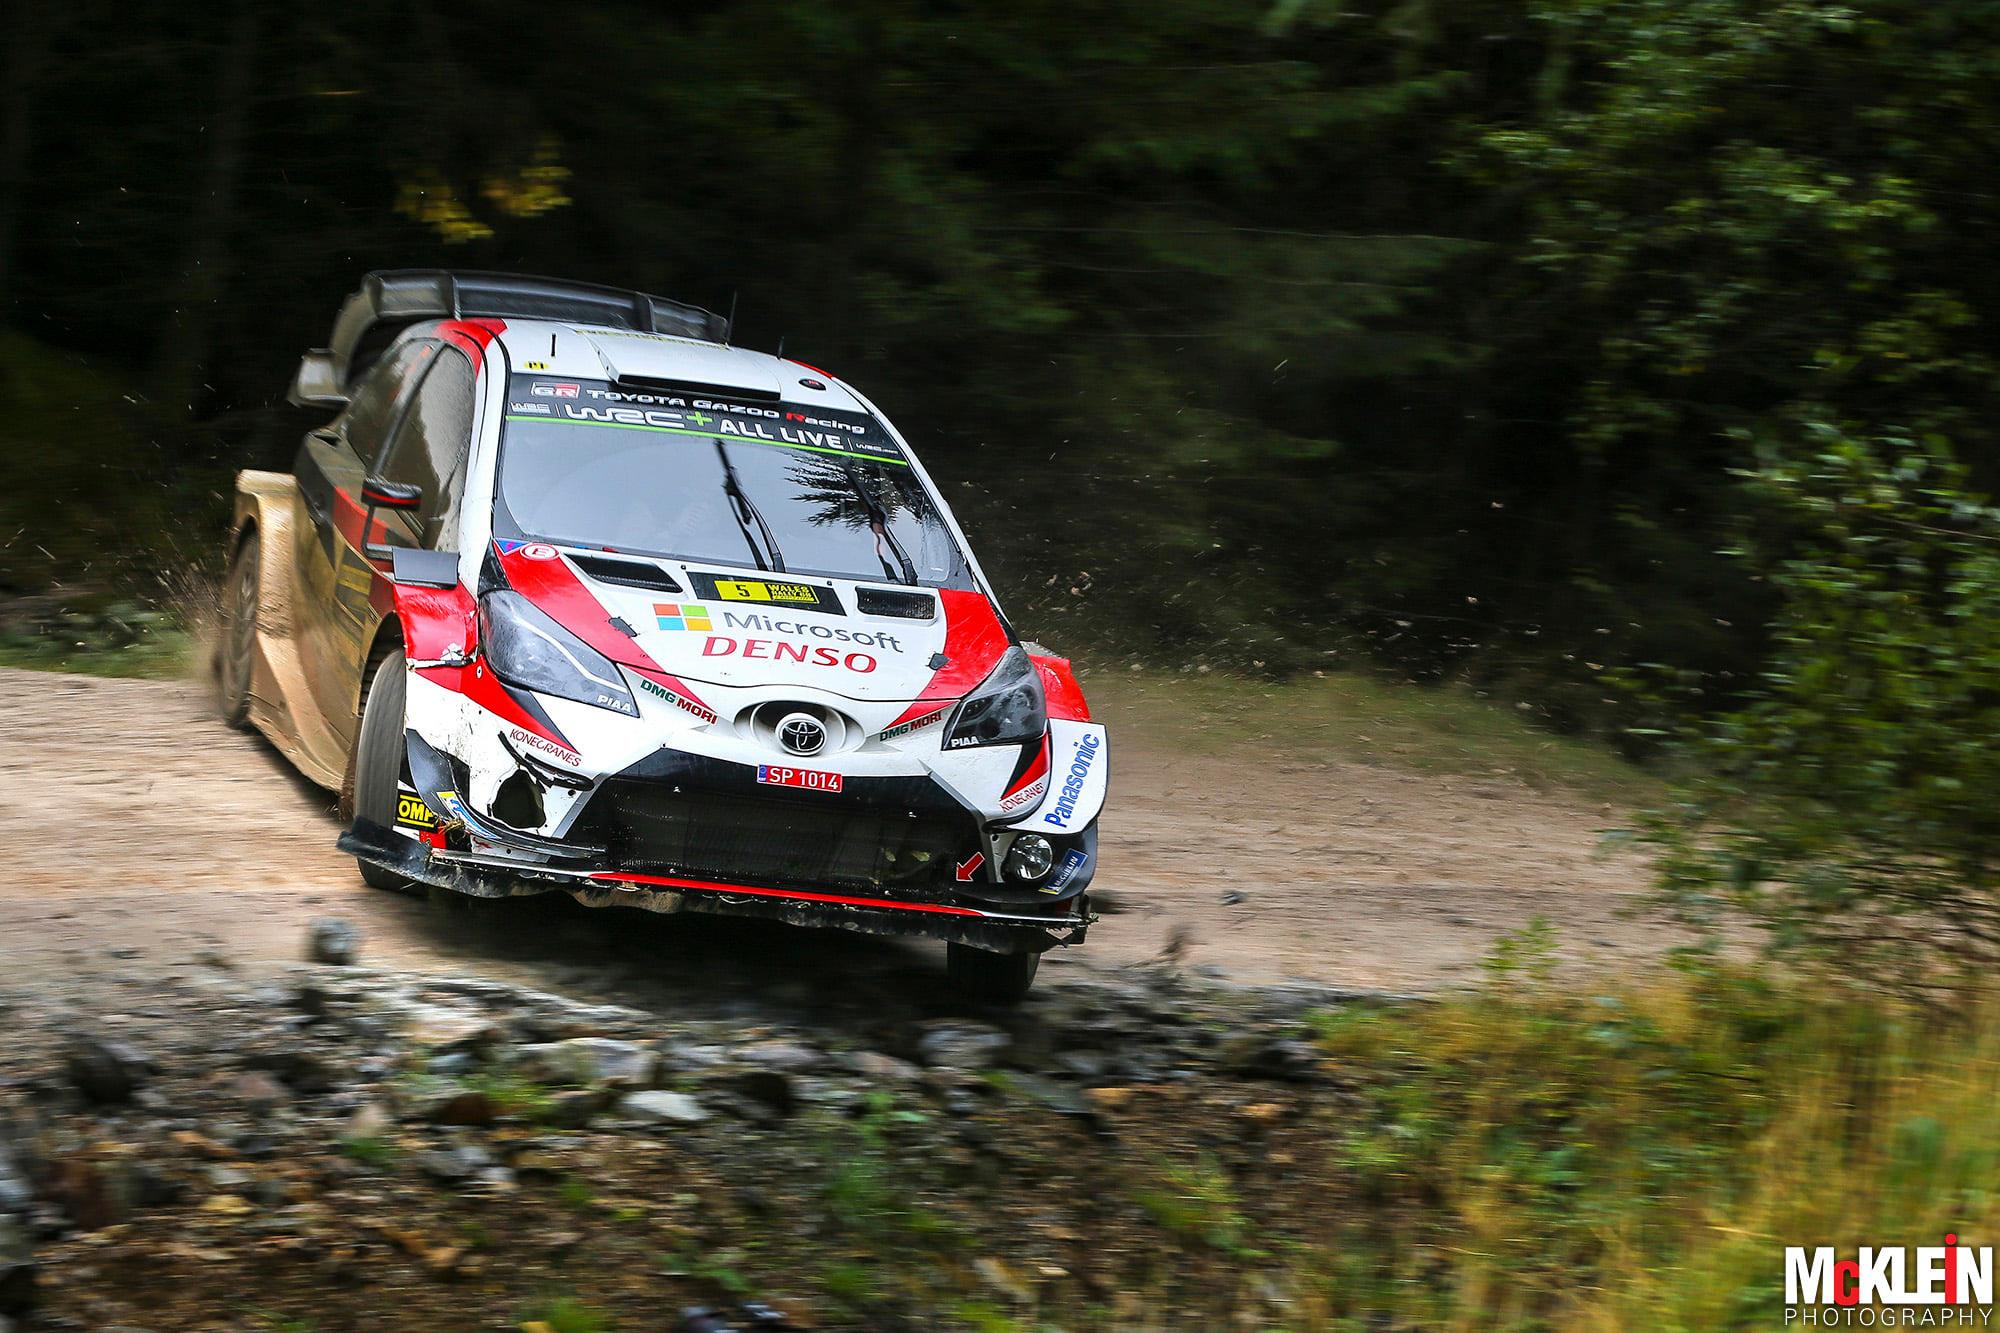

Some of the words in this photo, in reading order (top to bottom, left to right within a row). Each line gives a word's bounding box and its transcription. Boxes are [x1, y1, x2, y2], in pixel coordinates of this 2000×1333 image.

[531, 383, 580, 399] GR
[586, 389, 687, 408] TOYOTA
[692, 399, 780, 419] GAZOO
[785, 411, 866, 435] Racing
[720, 419, 775, 441] ALL
[779, 426, 845, 450] LIVE
[735, 584, 751, 598] 5
[767, 584, 810, 593] WALES
[723, 612, 904, 653] Microsoft
[702, 636, 878, 674] DENSO
[597, 694, 632, 713] PIAA
[640, 679, 677, 704] DMG
[676, 697, 718, 725] MORI
[879, 724, 910, 742] DMG
[910, 711, 942, 731] MORI
[950, 736, 980, 748] PIAA
[510, 729, 582, 767] KONECRANES
[769, 767, 794, 784] SP
[798, 770, 839, 790] 1014
[1043, 733, 1100, 829] Panasonic
[1053, 855, 1079, 886] MICHELIN
